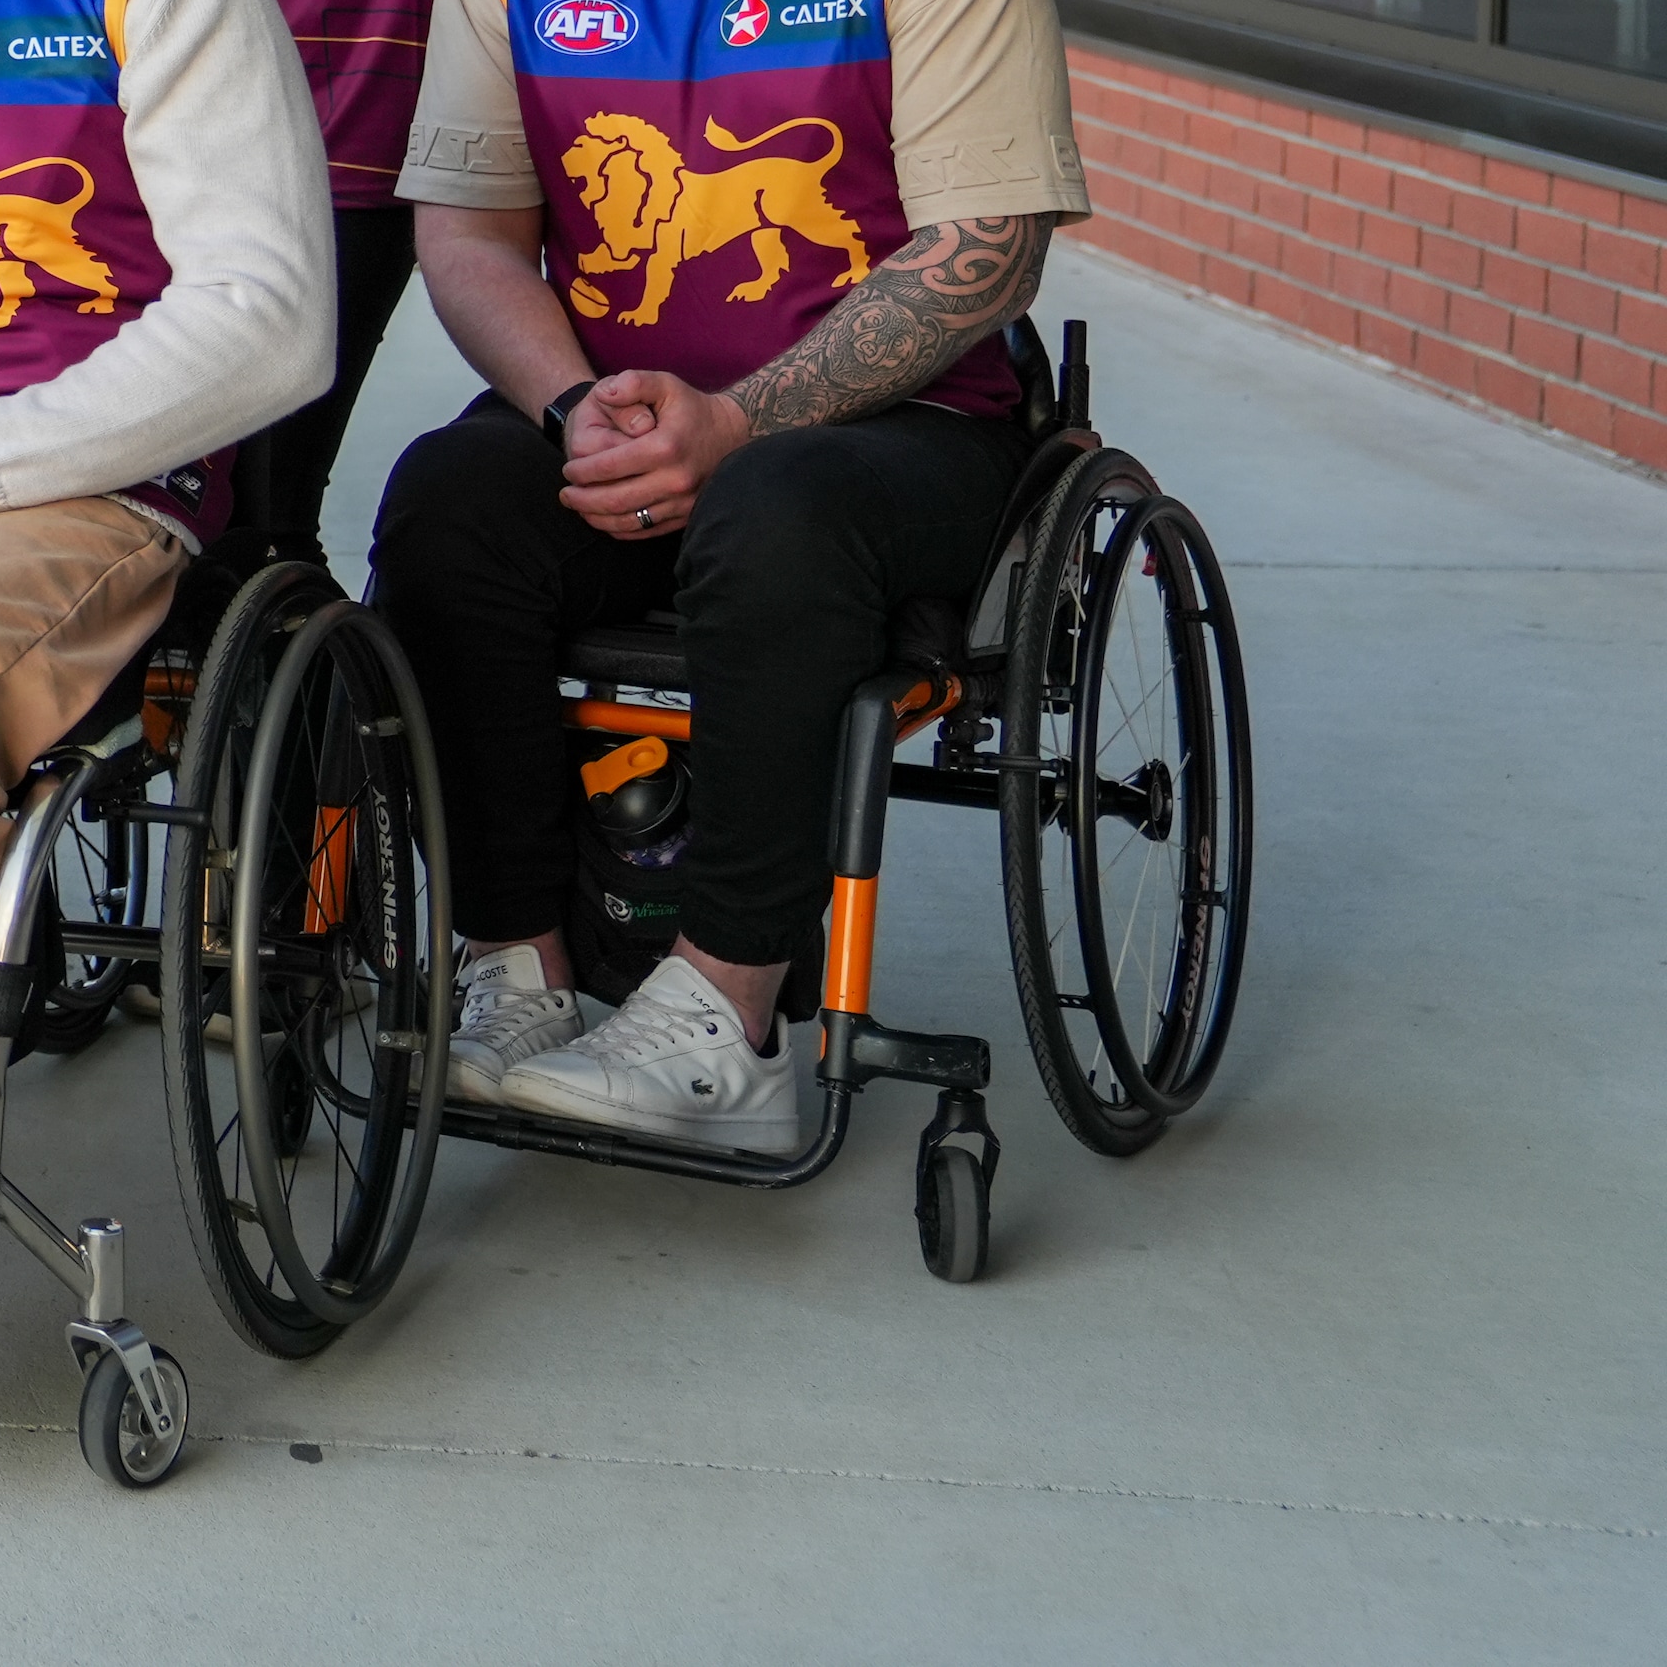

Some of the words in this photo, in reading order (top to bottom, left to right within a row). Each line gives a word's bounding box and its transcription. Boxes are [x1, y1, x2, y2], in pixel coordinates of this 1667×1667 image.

[543, 9, 627, 41] AFL
[8, 35, 107, 60] CALTEX
[372, 785, 398, 970] SPINERGY
[1182, 835, 1211, 1031] SPNERGY
[476, 964, 509, 982] ACOSTE
